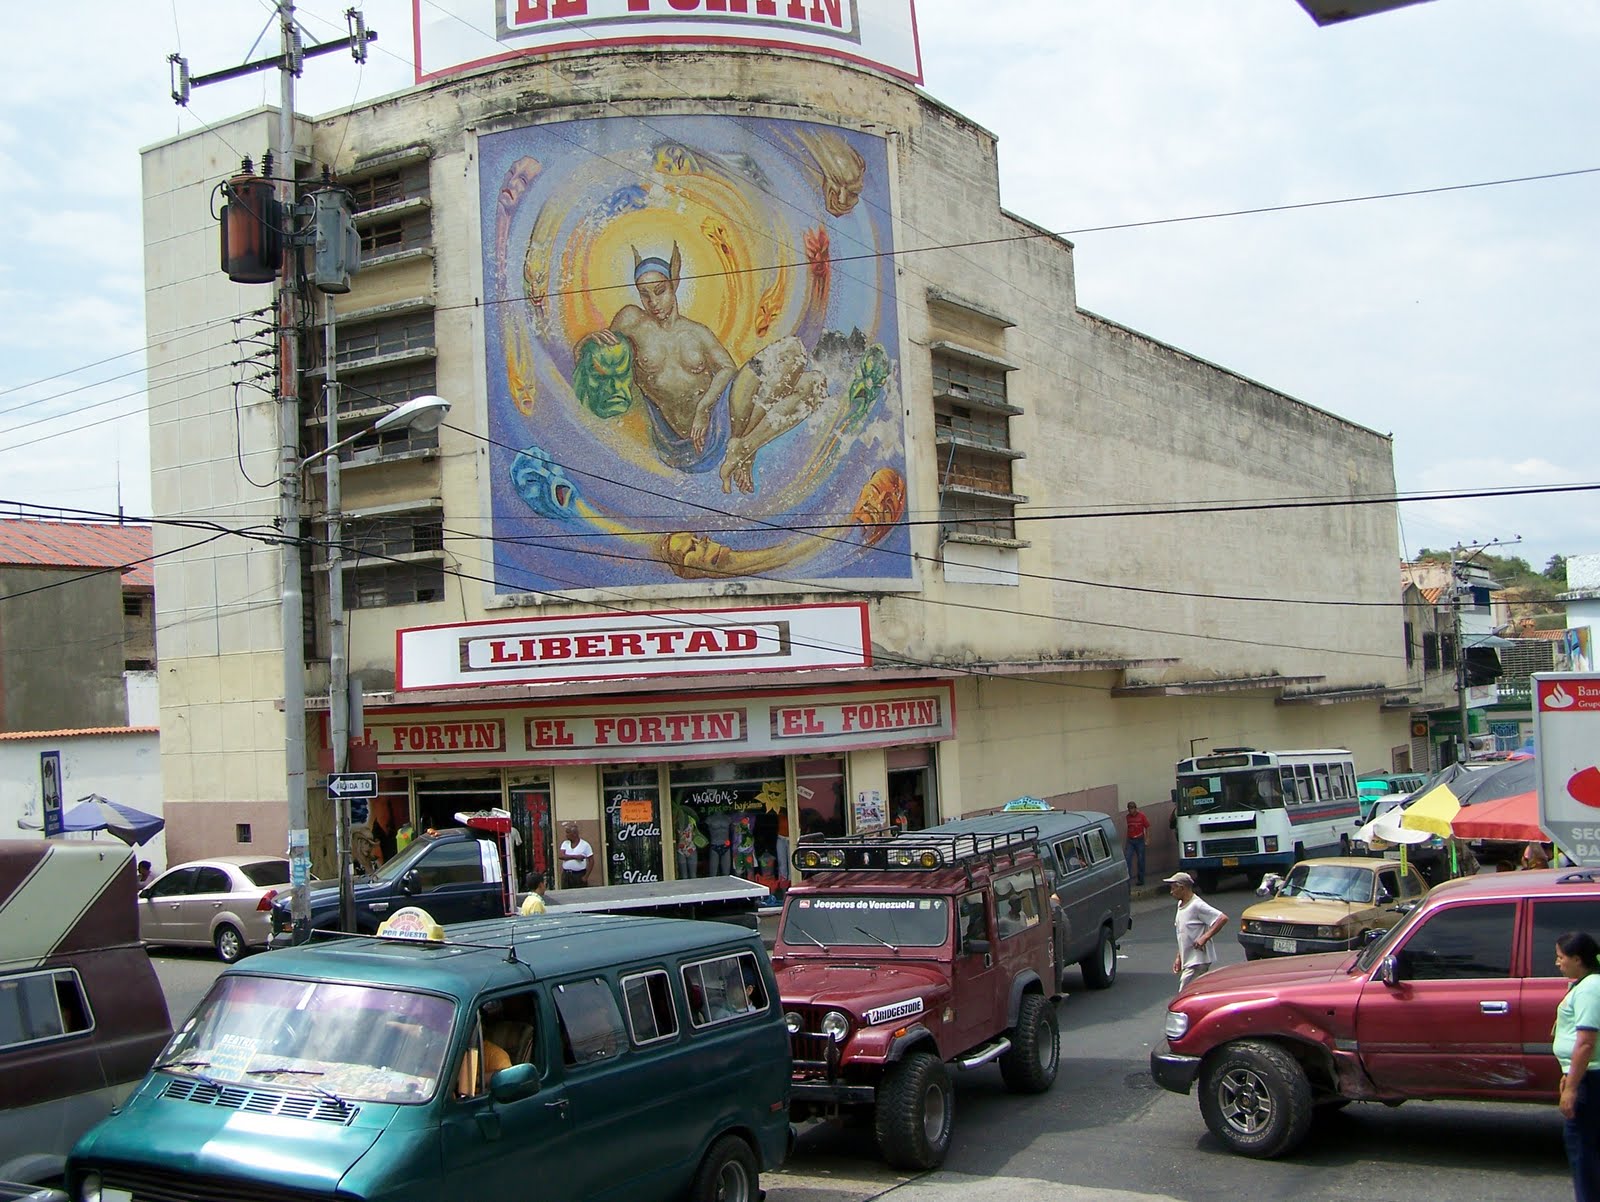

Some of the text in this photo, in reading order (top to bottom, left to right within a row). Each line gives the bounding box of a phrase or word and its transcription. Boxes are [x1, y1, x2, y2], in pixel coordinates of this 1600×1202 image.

[490, 629, 758, 663] LIBERTAD
[782, 700, 933, 735] EL FORTIN
[393, 722, 496, 750] FORTIN
[535, 712, 735, 745] EL FORTIN
[618, 823, 660, 841] Moda
[612, 852, 626, 861] es
[623, 870, 658, 883] Vida
[814, 899, 915, 910] Jeeperos de Venezuela
[399, 930, 428, 939] PUESTO
[872, 1000, 921, 1022] BRIDGESTONE
